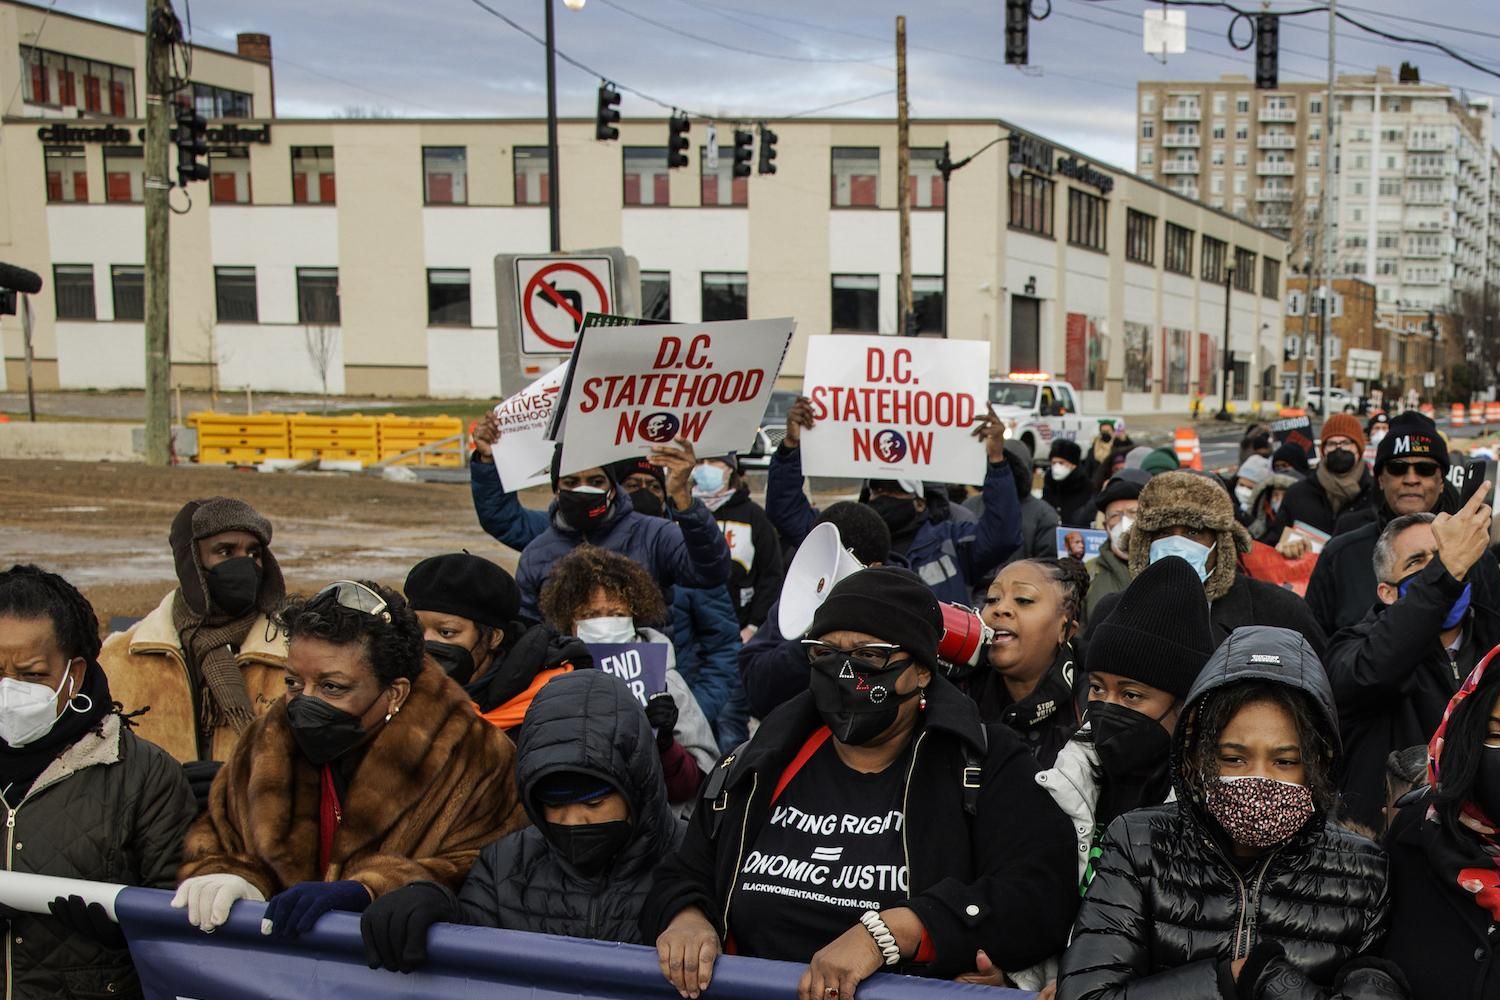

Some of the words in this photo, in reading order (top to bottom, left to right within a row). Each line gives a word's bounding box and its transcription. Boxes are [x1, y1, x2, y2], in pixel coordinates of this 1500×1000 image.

[653, 334, 713, 370] D.C.
[866, 347, 919, 385] D.C.
[497, 393, 552, 416] ATIVES
[580, 369, 764, 413] STATEHOOD
[811, 386, 974, 428] STATEHOOD
[497, 408, 553, 427] TATEHOO
[1036, 700, 1055, 711] STOP
[742, 851, 830, 885] ONOMIC
[832, 865, 910, 892] JUSTIC
[742, 882, 881, 910] BLACKWOMENTAKEACTION.ORG
